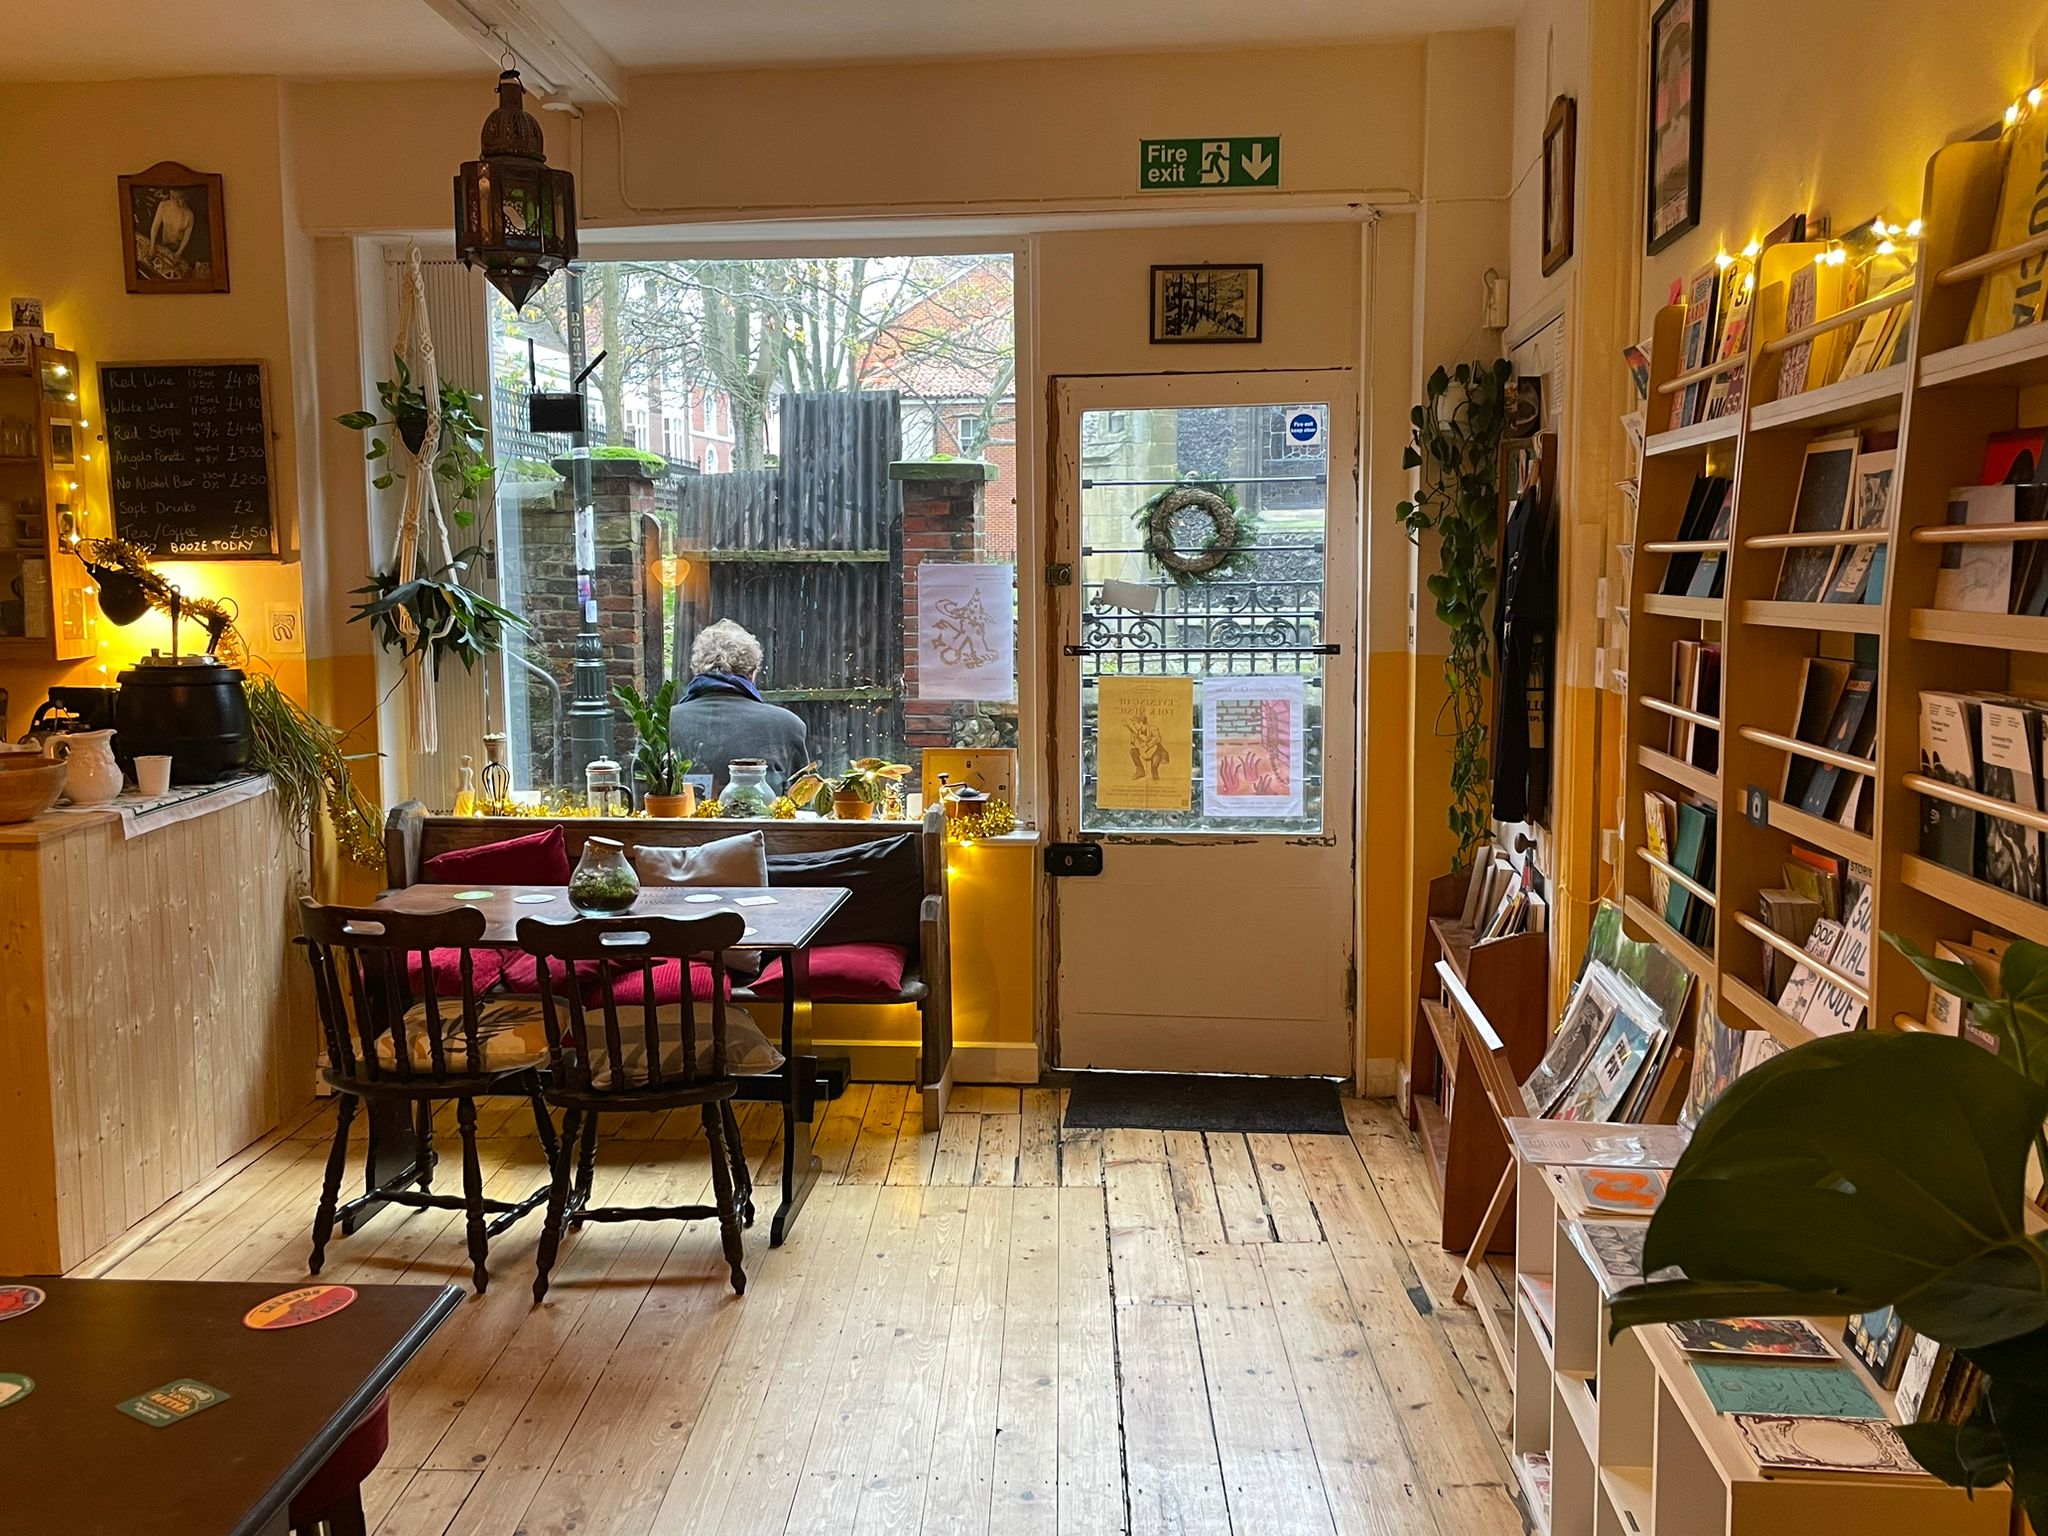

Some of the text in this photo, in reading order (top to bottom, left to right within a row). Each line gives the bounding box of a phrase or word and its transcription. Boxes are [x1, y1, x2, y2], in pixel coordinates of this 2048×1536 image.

[1148, 145, 1187, 163] Fire
[1148, 164, 1185, 183] exit
[109, 371, 137, 389] Red
[143, 372, 176, 388] Wine
[111, 398, 143, 414] White
[145, 397, 177, 410] Wine
[113, 425, 142, 441] Red
[116, 478, 132, 490] No
[119, 499, 255, 518] Soft Drinks £2
[170, 540, 208, 553] BOOZE
[211, 540, 254, 551] TODAY
